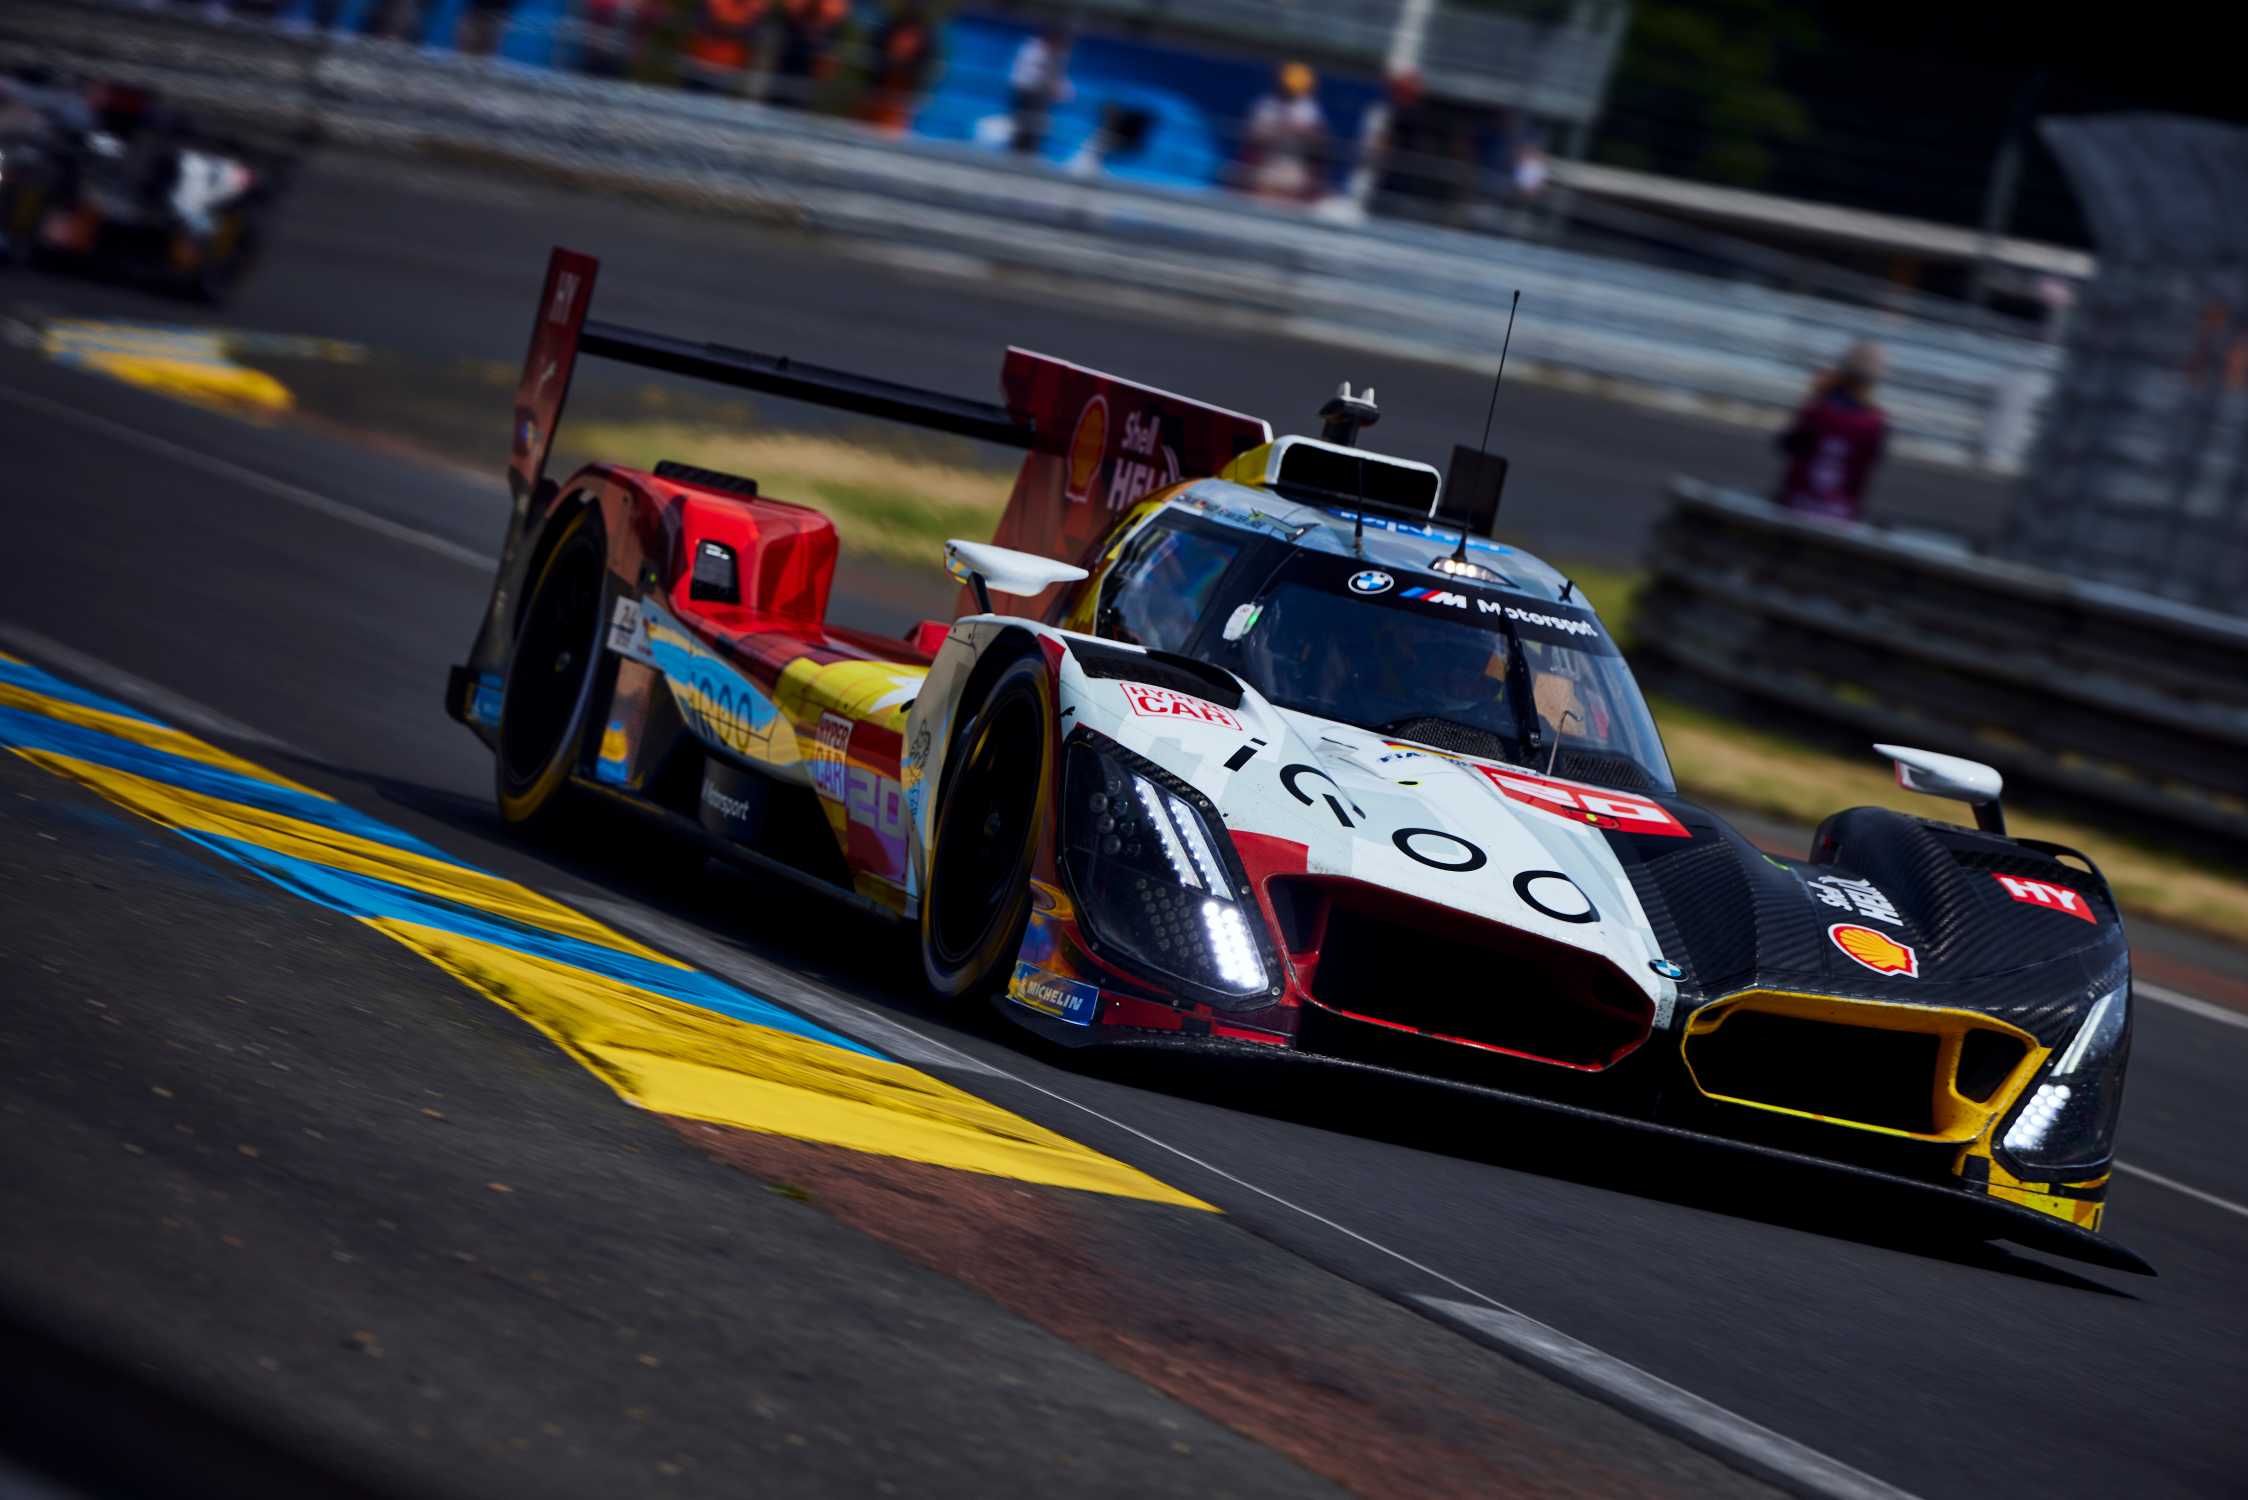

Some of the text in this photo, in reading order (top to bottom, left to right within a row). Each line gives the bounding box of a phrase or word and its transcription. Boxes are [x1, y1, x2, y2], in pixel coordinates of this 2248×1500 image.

[1477, 599, 1598, 637] Motorsport
[1138, 696, 1231, 725] CAR
[815, 746, 846, 797] CAR
[849, 767, 907, 838] 20
[1999, 876, 2077, 911] HY
[1027, 981, 1084, 1011] MICHELIN
